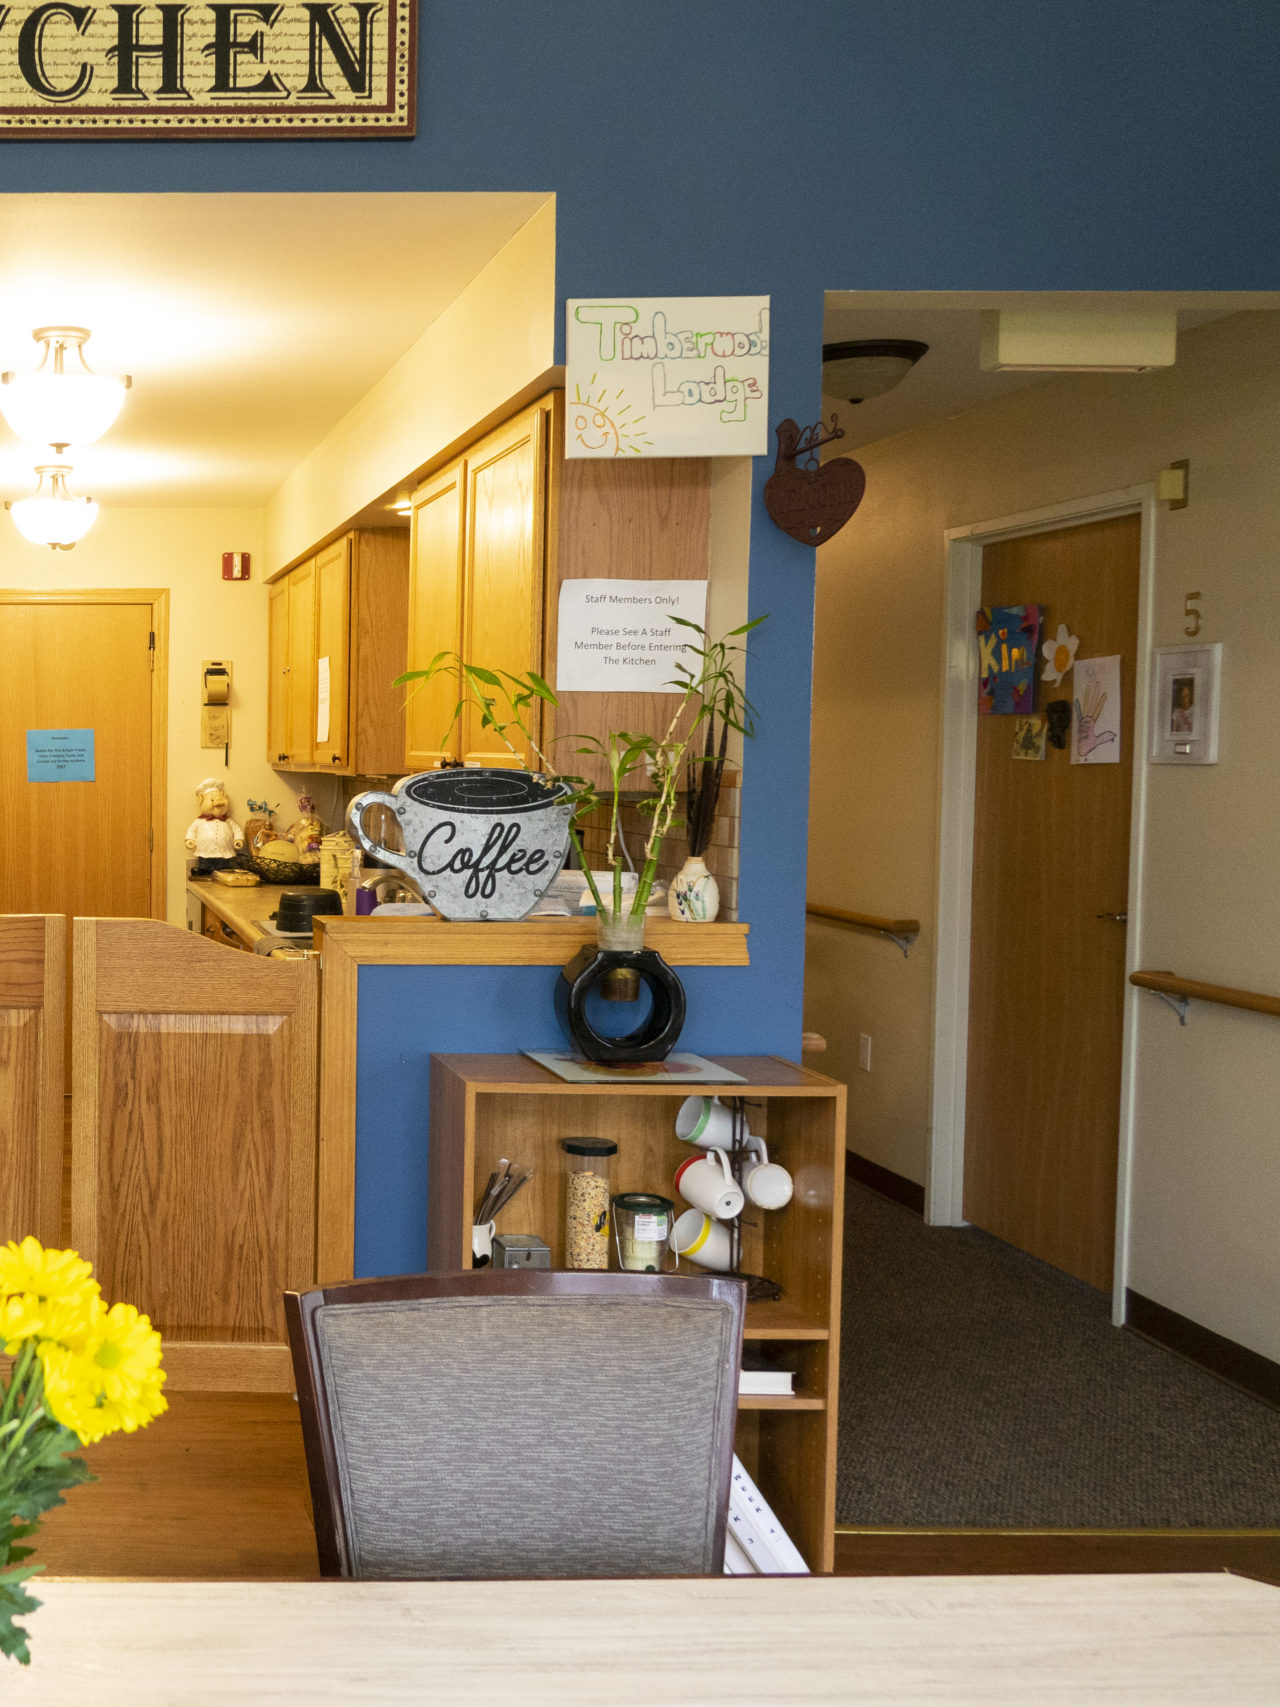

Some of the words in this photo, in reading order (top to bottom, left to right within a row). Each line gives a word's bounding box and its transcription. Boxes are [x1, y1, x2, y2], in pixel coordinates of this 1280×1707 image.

[651, 362, 763, 423] Lodge
[585, 594, 608, 604] Staff
[609, 595, 652, 605] Members
[654, 595, 680, 606] Only!
[1183, 591, 1202, 637] 5
[591, 626, 620, 637] Please
[622, 627, 639, 637] See
[640, 627, 648, 637] A
[650, 627, 671, 637] Staff
[574, 641, 614, 651] Member
[615, 642, 646, 652] Before
[648, 642, 687, 653] Entering
[603, 656, 620, 665] The
[622, 656, 657, 666] Kitchen
[417, 821, 549, 899] Coffee
